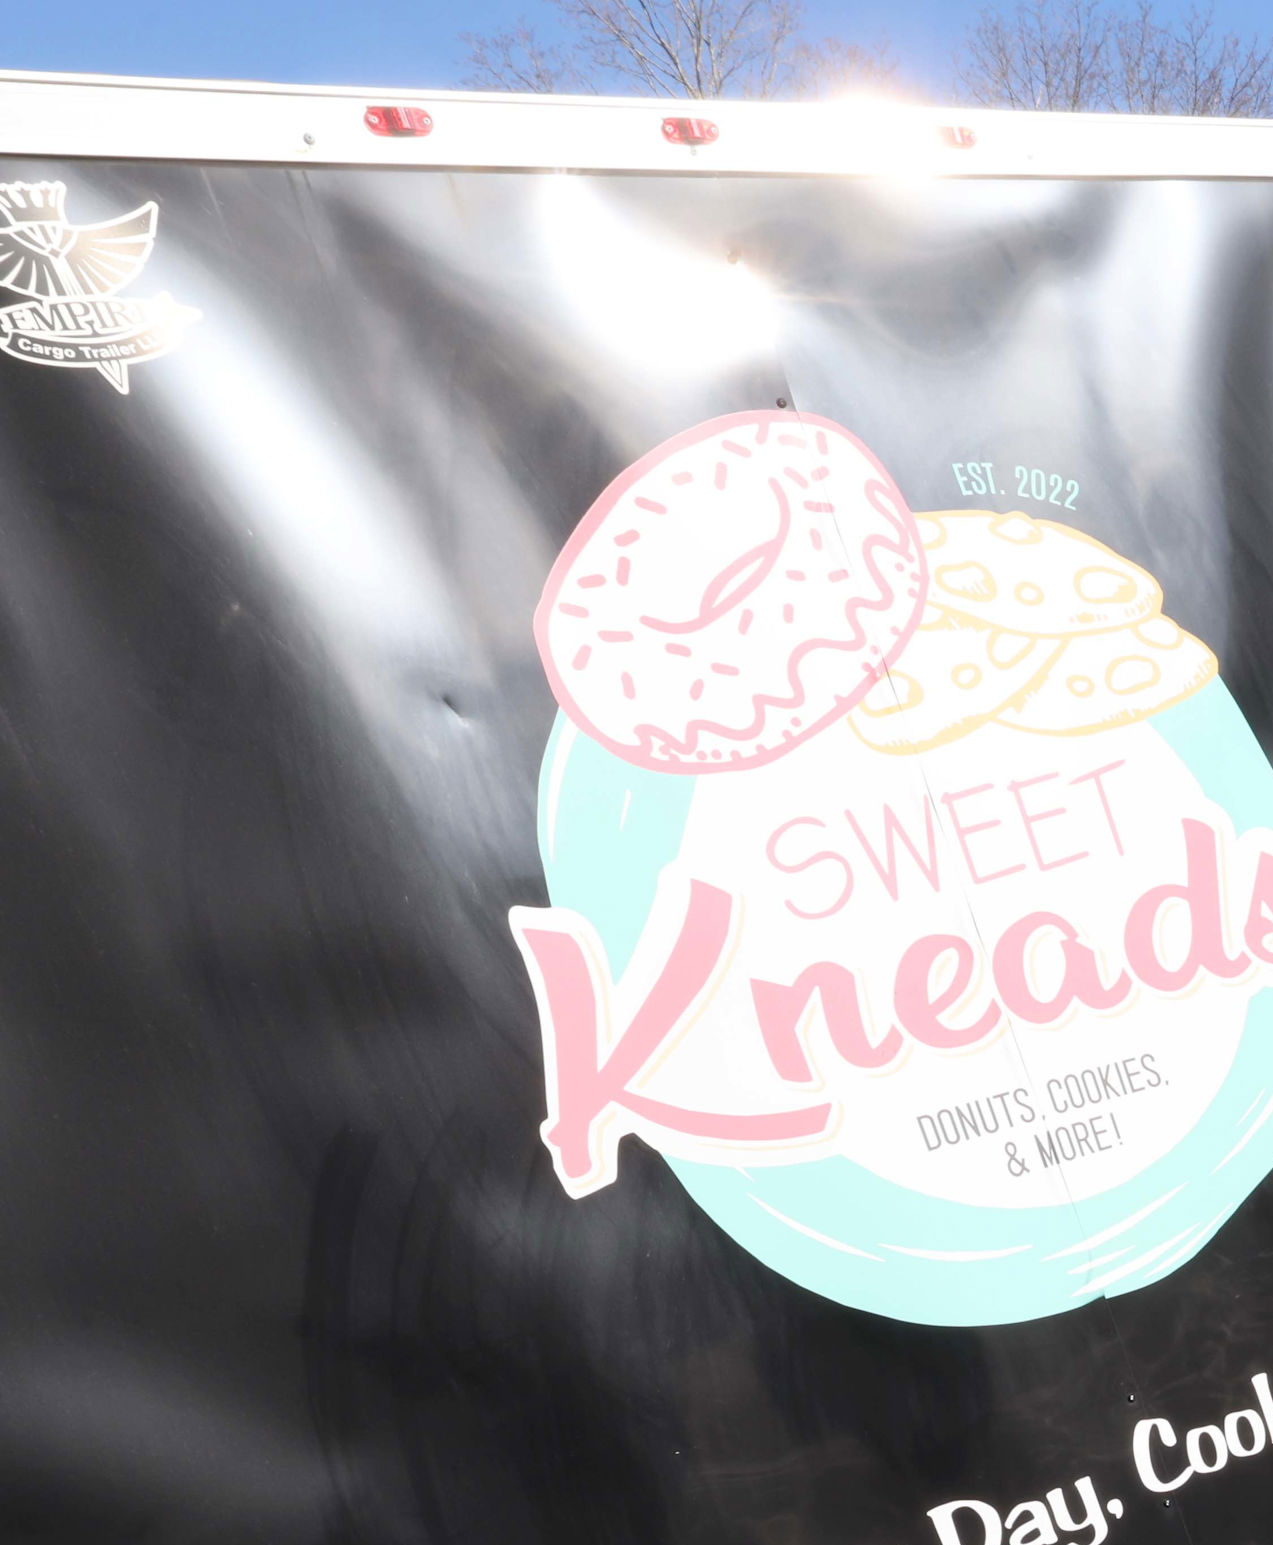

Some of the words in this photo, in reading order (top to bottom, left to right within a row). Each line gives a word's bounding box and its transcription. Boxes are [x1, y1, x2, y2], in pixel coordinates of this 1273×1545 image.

[5, 300, 147, 332] EMPIR
[18, 337, 76, 360] Cargo
[79, 343, 138, 360] Trailer
[952, 462, 1006, 496] EST.
[1015, 465, 1080, 511] 2022
[765, 759, 1127, 920] SWEET
[916, 1088, 1046, 1151] DONUTS,
[1004, 1141, 1031, 1178] &
[1034, 1112, 1124, 1169] MORE!
